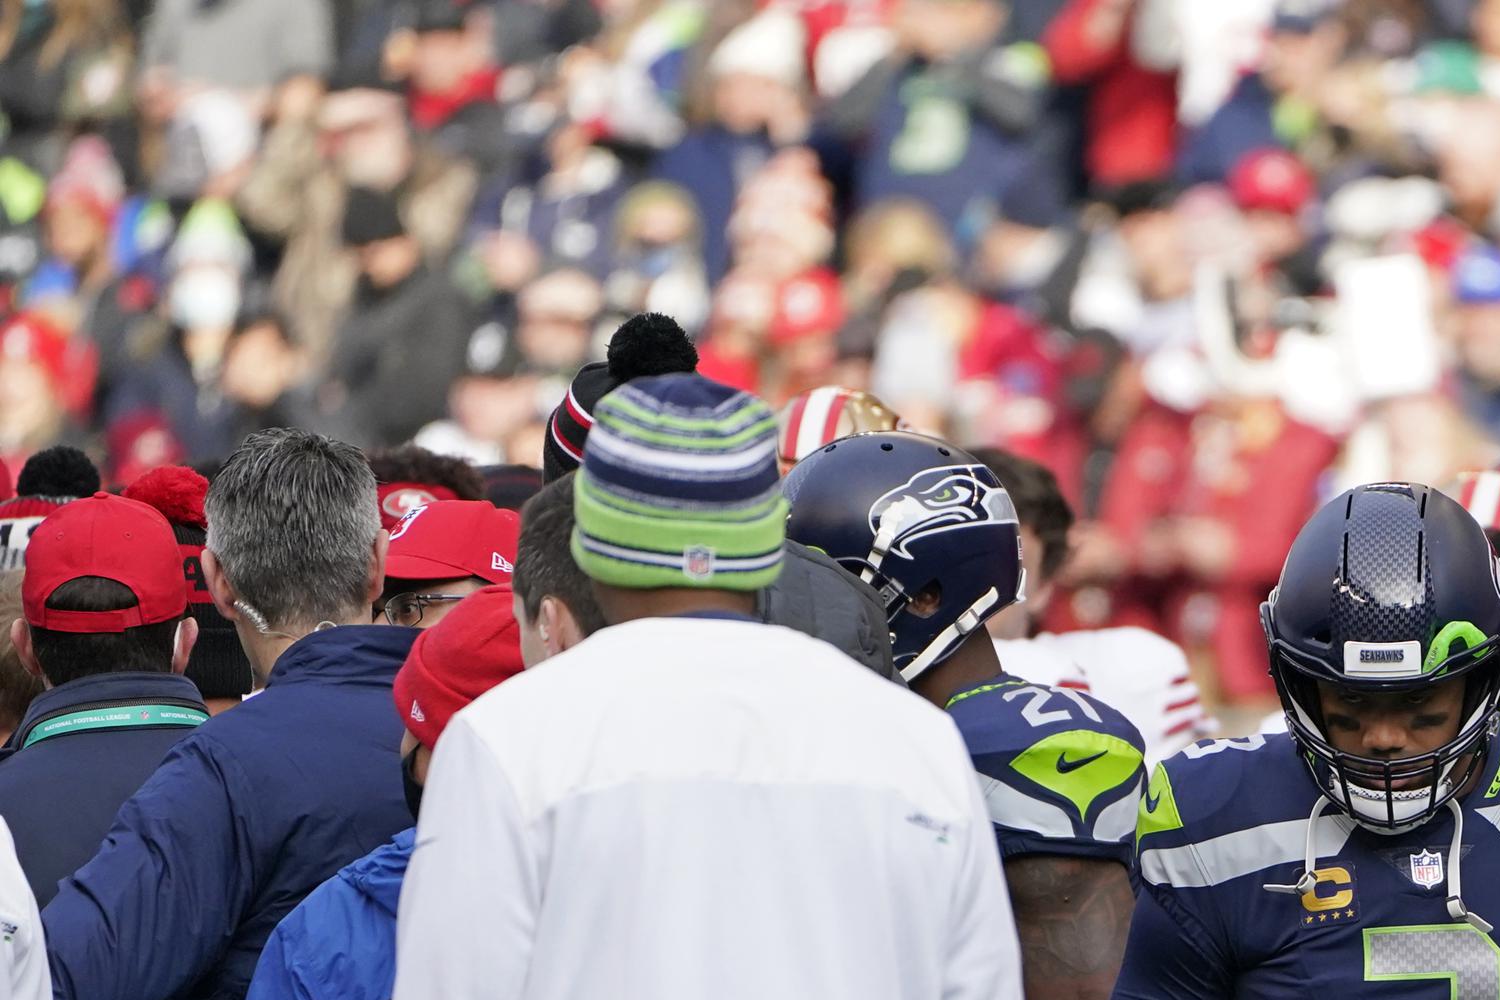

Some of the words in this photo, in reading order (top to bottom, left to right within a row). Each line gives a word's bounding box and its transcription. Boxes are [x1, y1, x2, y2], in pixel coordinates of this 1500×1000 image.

[1359, 649, 1405, 663] SEAHAWKS
[73, 716, 105, 725] FOOTBALL
[106, 713, 131, 721] LEAGUE
[1416, 867, 1440, 880] NFL
[1301, 866, 1352, 912] C
